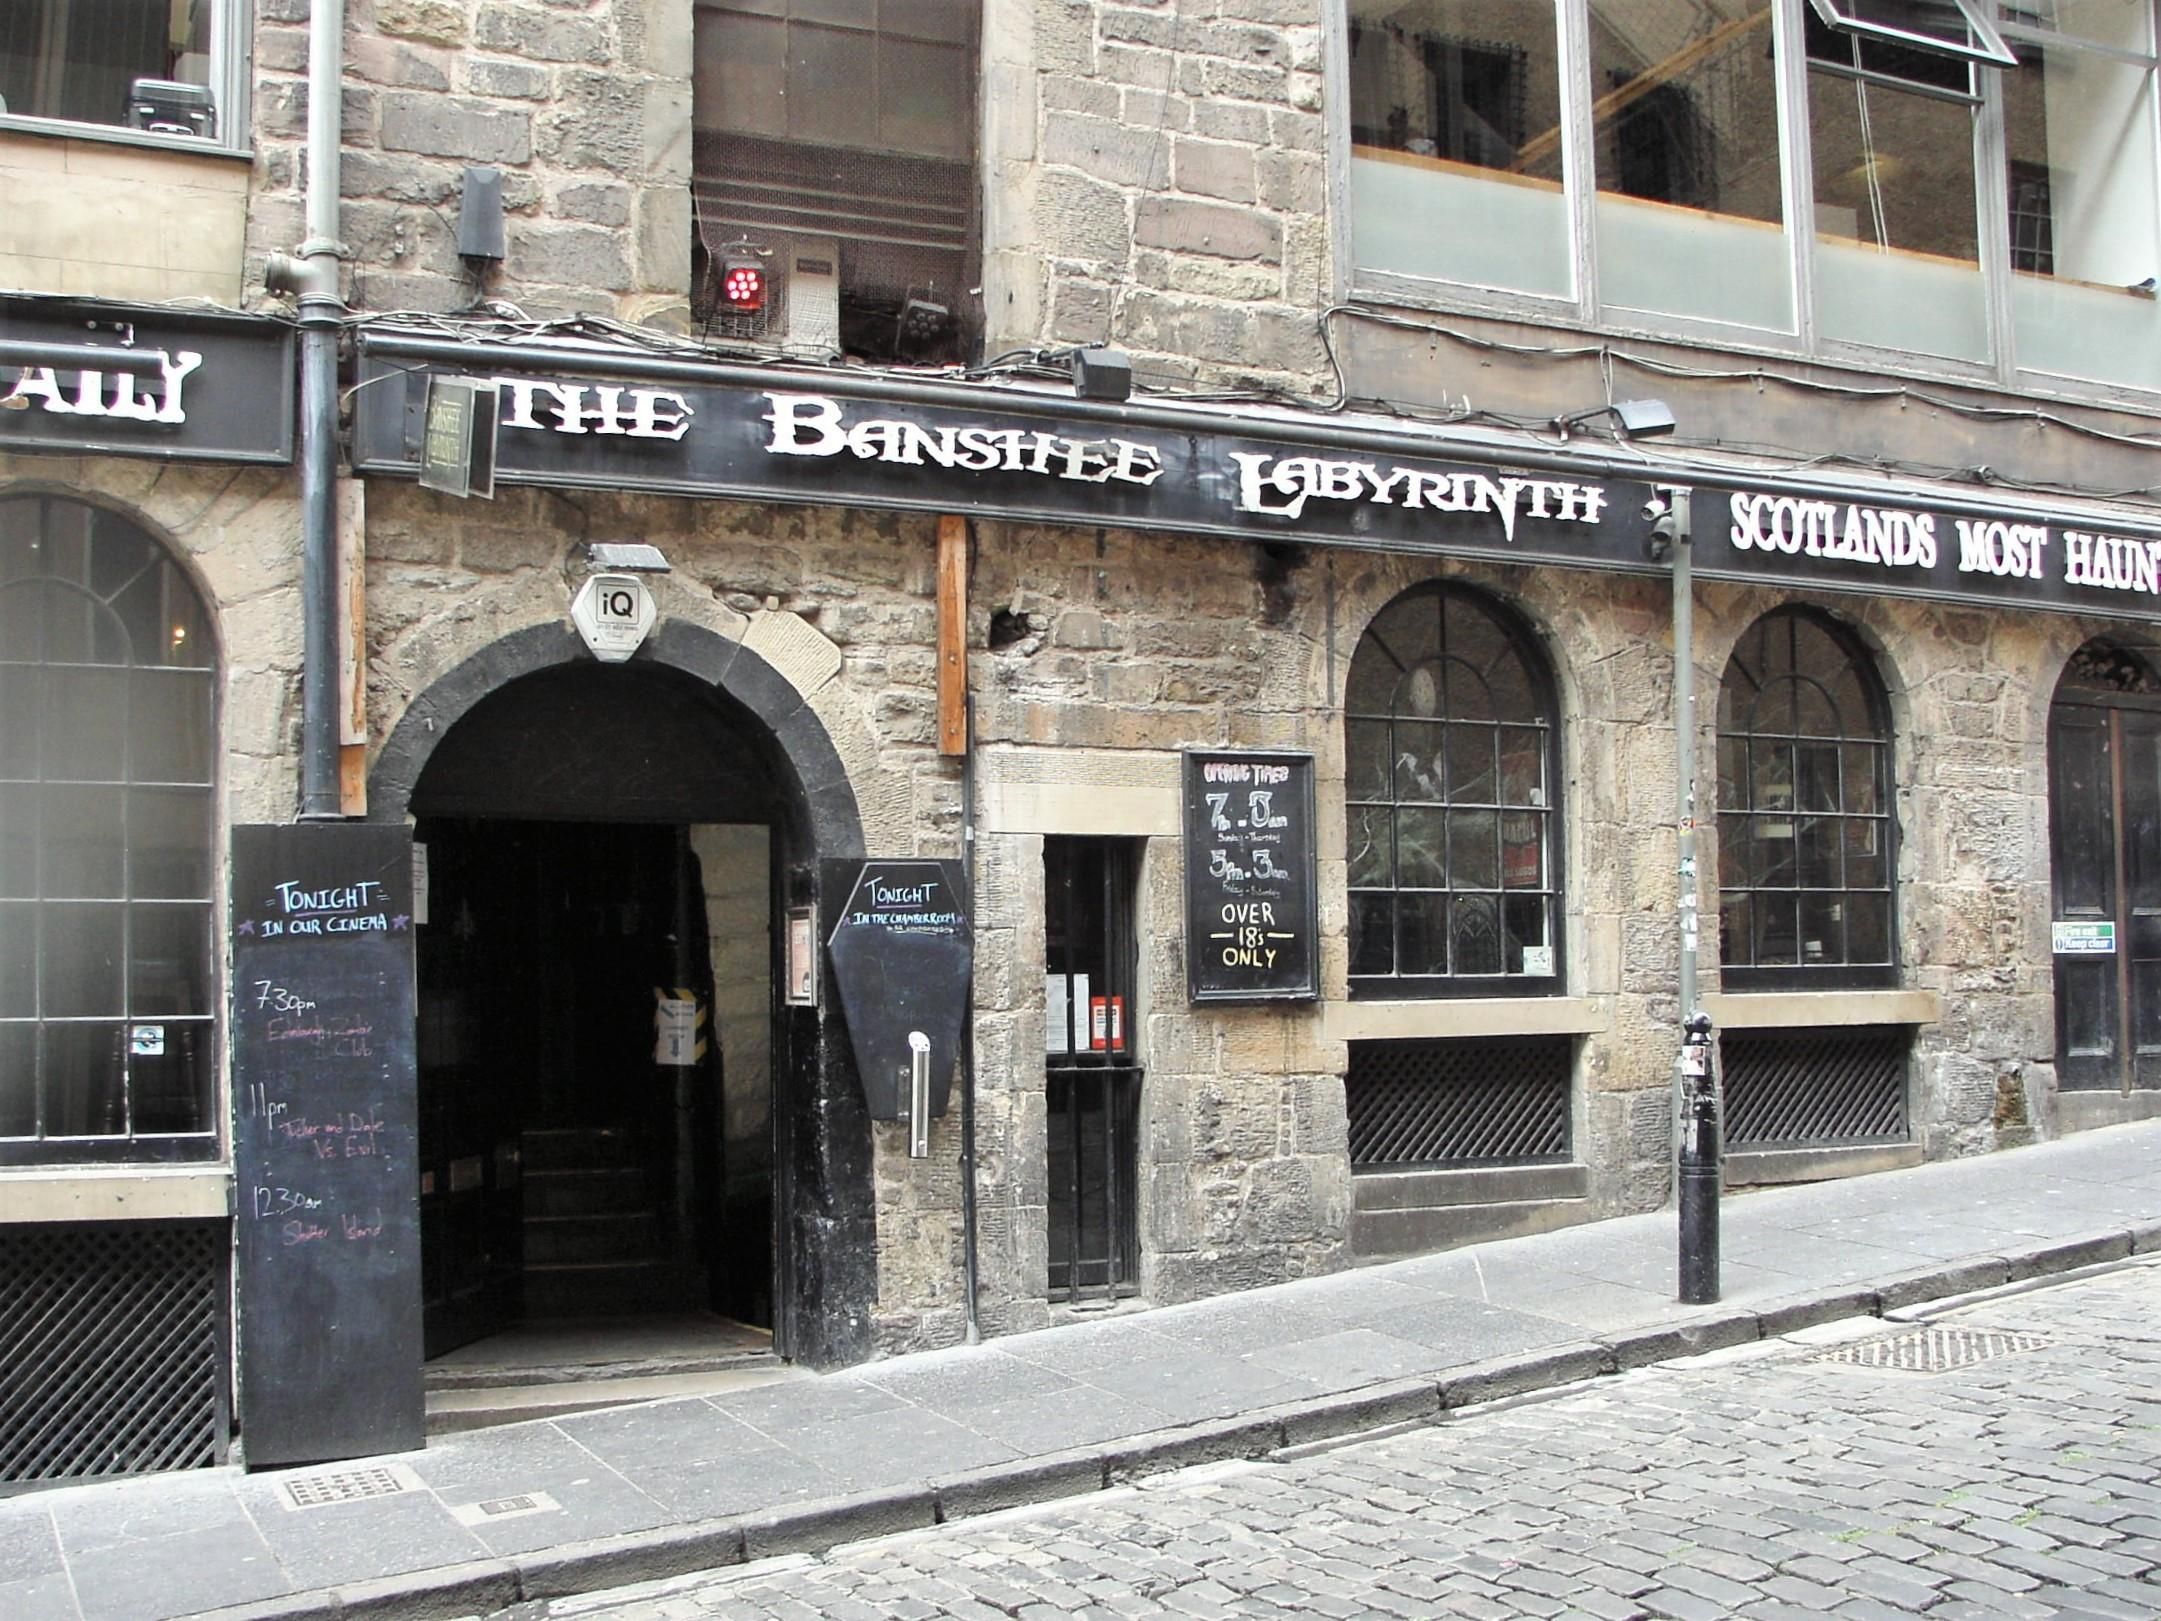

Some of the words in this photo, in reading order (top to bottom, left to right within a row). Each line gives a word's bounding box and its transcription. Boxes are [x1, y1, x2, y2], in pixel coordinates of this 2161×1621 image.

[492, 375, 697, 442] THE
[762, 391, 1166, 486] BANSHEE
[1229, 450, 1606, 541] LABYRINTH
[1729, 491, 1937, 569] SCOTLANDS
[1955, 519, 2048, 579] MOST
[2063, 531, 2161, 595] HAUN
[602, 590, 634, 618] iQ
[274, 880, 381, 913] TONIGHT
[864, 876, 939, 906] TONIGHT
[261, 921, 283, 938] IN
[290, 919, 322, 935] OUR
[327, 913, 388, 932] CINEMA
[1221, 902, 1276, 926] OVER
[1222, 948, 1277, 968] ONLY
